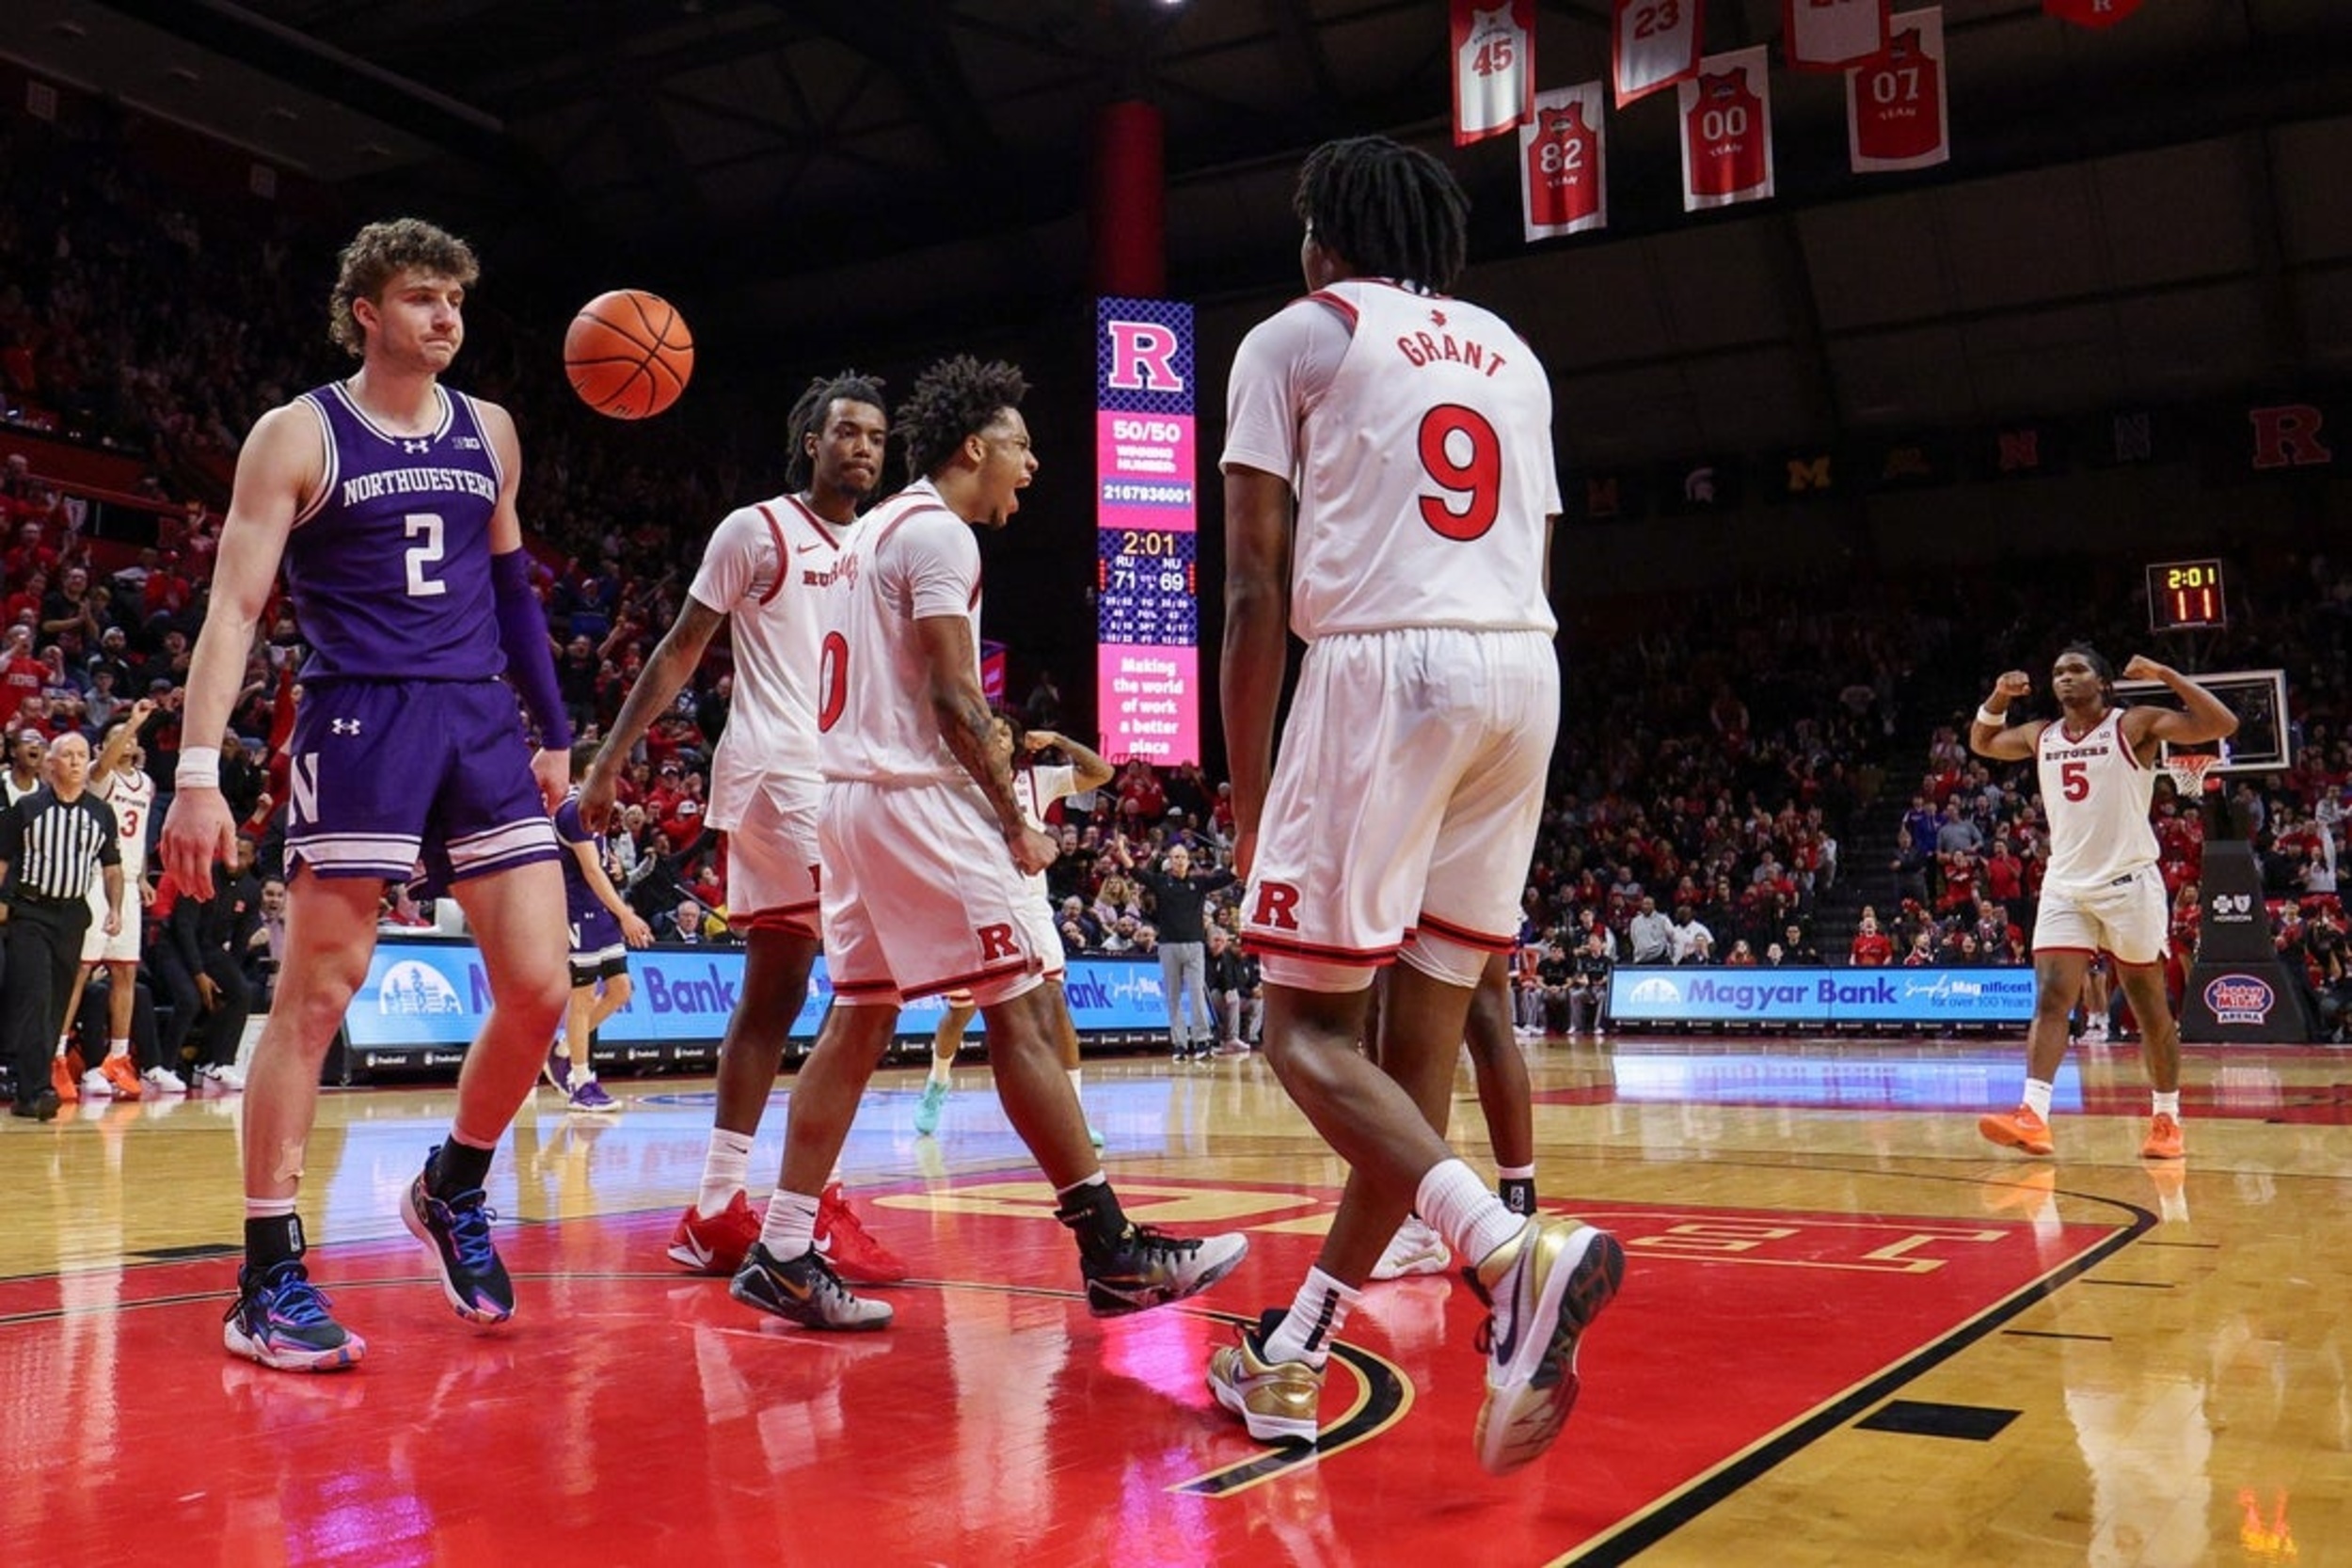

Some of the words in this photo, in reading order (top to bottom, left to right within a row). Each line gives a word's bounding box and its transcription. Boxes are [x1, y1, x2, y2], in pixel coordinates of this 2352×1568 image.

[1634, 0, 1679, 40] 23
[1471, 38, 1513, 77] 45
[1872, 68, 1918, 103] 07
[1703, 106, 1747, 140] 00
[1540, 138, 1582, 173] 82
[1108, 321, 1184, 392] R
[1396, 331, 1506, 377] GRANT
[1113, 420, 1182, 443] 50/50
[2249, 404, 2330, 469] R
[342, 467, 496, 508] NORTHWESTERN
[1418, 403, 1502, 543] 9
[405, 513, 447, 596] 2
[1123, 531, 1174, 557] 2:01
[1114, 570, 1136, 590] 71
[1159, 572, 1184, 592] 69
[2168, 566, 2215, 590] 2:01
[2178, 588, 2212, 621] 11
[818, 631, 849, 734] 0
[1121, 657, 1177, 676] Making
[1113, 677, 1138, 694] the
[1141, 679, 1184, 695] world
[1121, 698, 1137, 713] of
[1140, 699, 1177, 715] work
[1120, 721, 1130, 734] a
[1133, 719, 1179, 735] better
[288, 752, 319, 827] N
[2061, 761, 2090, 803] 5
[119, 809, 138, 838] 3
[1250, 879, 1300, 930] R
[977, 922, 1019, 961] R
[643, 962, 736, 1014] Bank
[1064, 969, 1114, 1010] ank
[1687, 978, 1809, 1010] Magyar
[1817, 976, 1899, 1006] Bank
[1950, 980, 2033, 997] Magnificent
[2002, 997, 2033, 1008] Years
